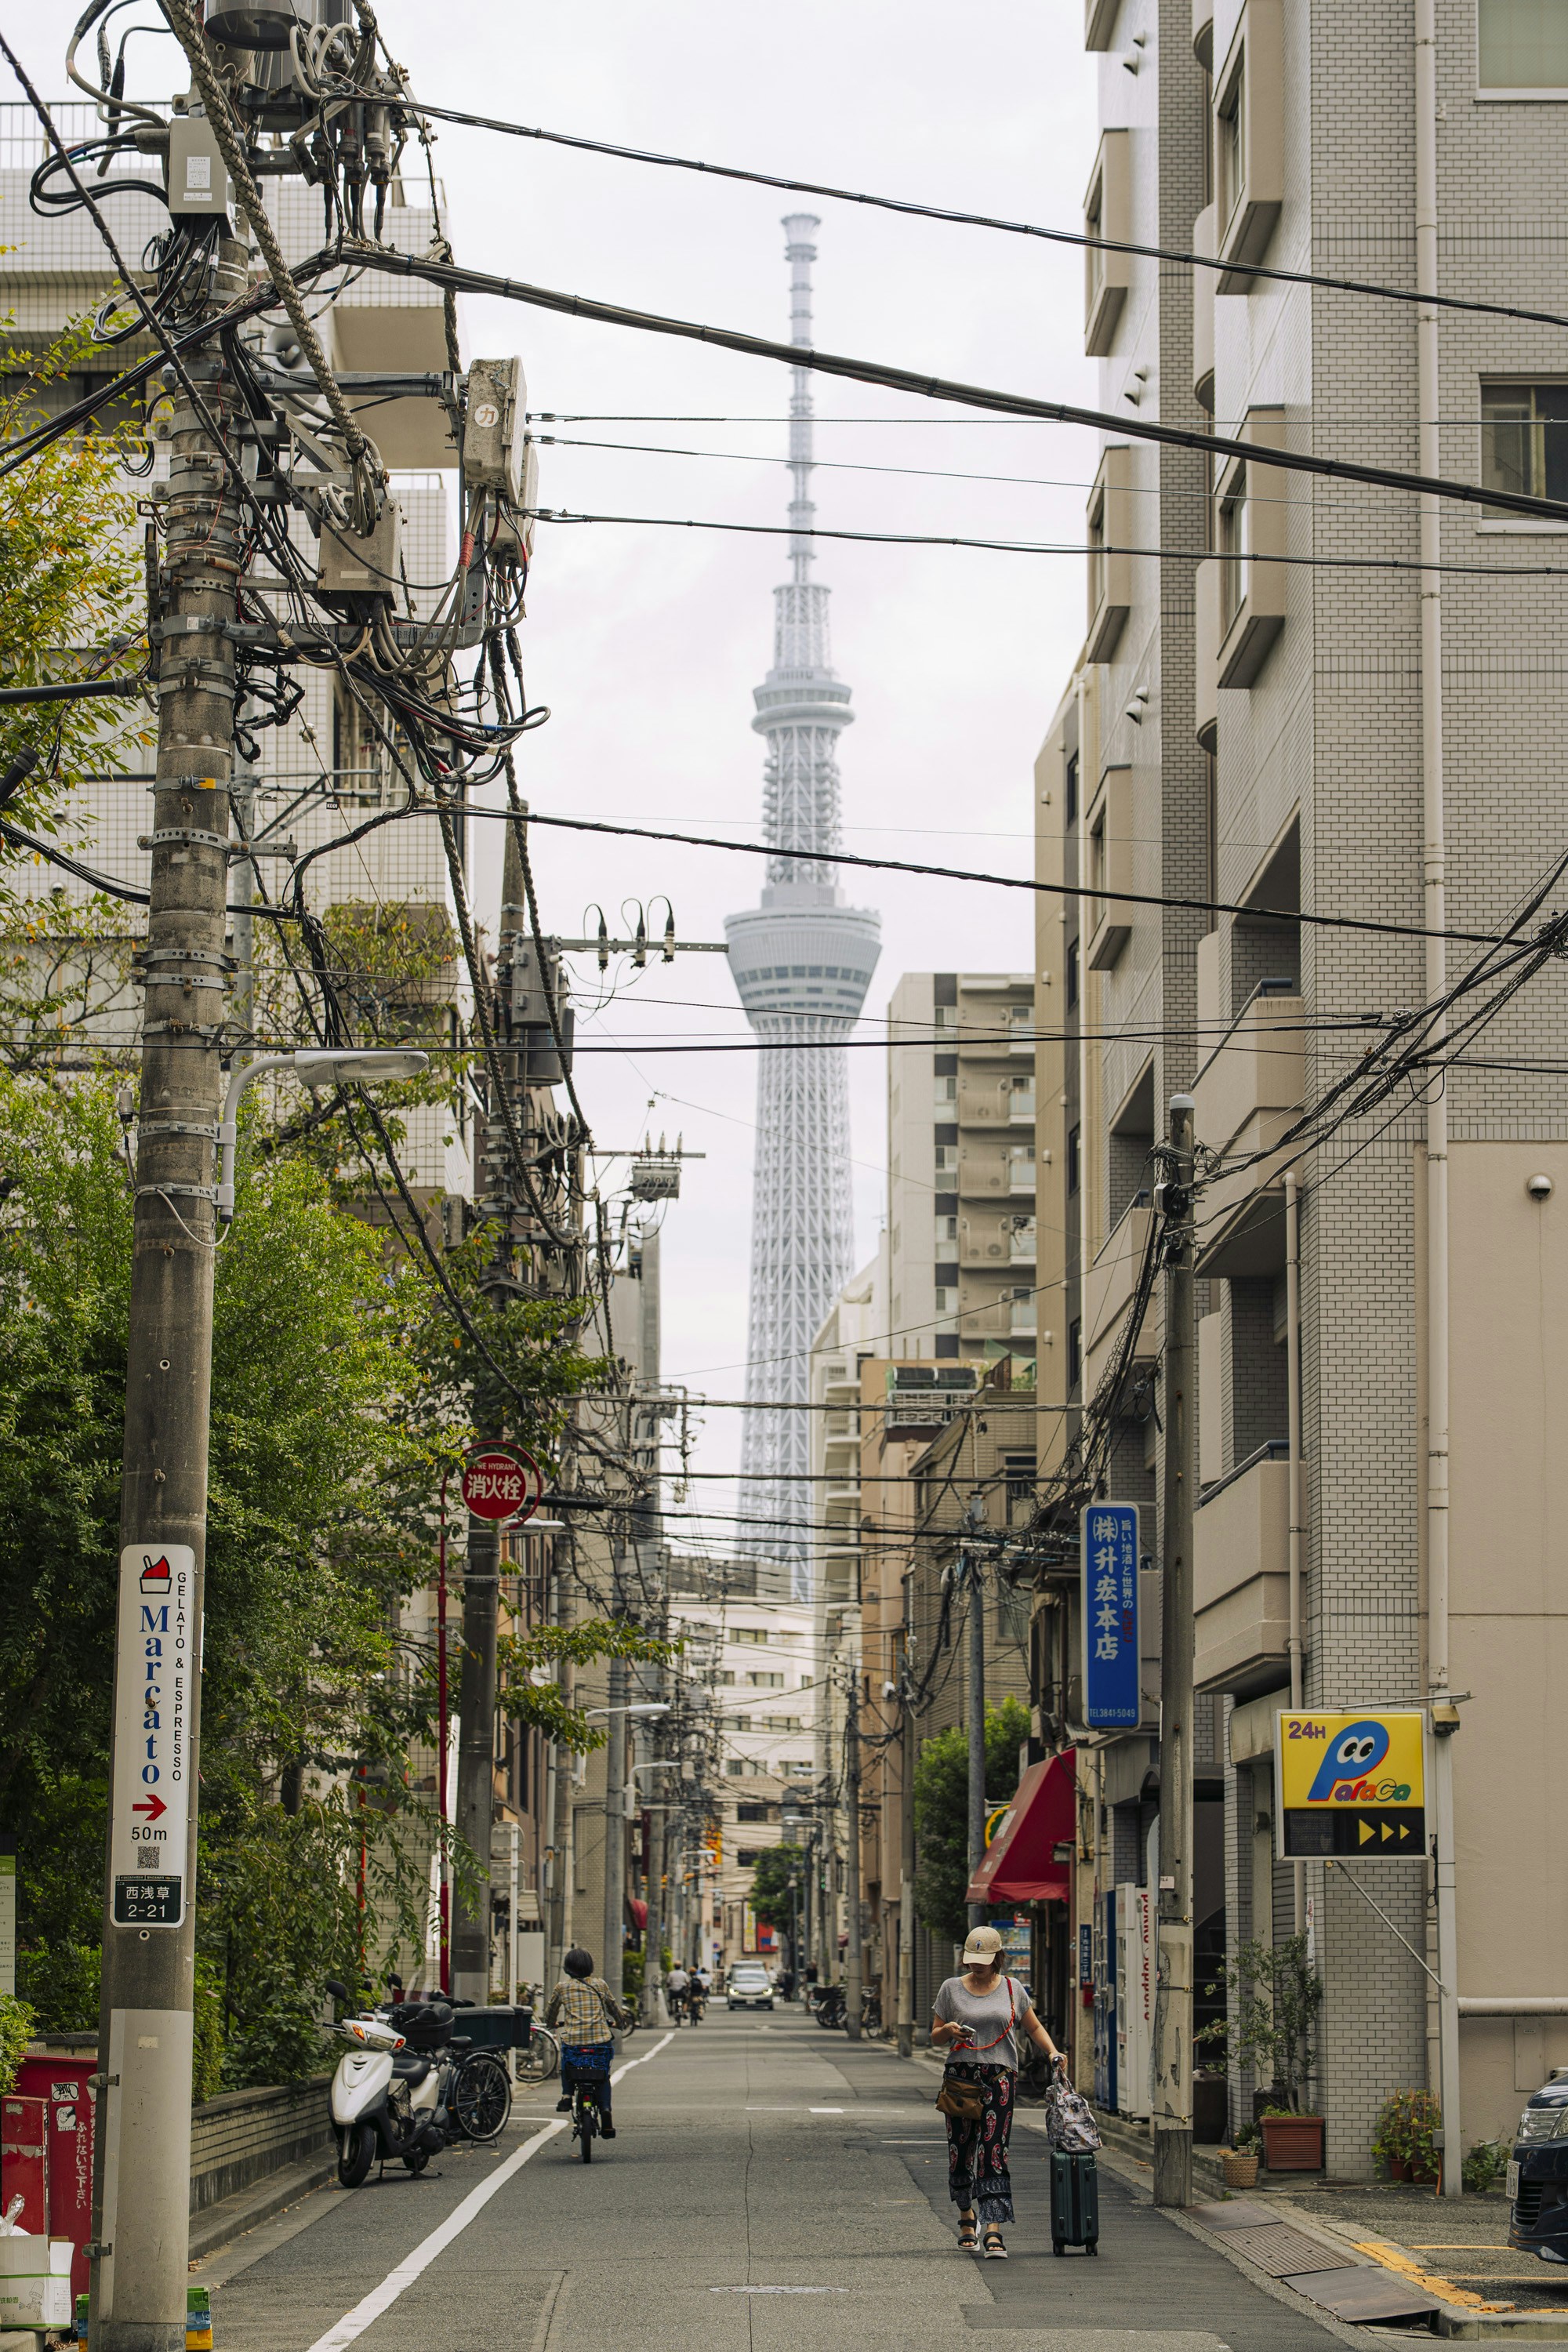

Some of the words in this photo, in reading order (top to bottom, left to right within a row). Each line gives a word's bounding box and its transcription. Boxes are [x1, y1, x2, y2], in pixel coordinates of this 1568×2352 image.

[479, 407, 495, 424] 力
[488, 1462, 517, 1471] HYDRANT
[466, 1474, 522, 1501] 消火栓
[175, 1572, 187, 1649] GELATO
[175, 1657, 184, 1669] &
[139, 1605, 171, 1784] Marcato
[172, 1677, 183, 1781] ESPRESSO
[1288, 1721, 1327, 1739] 24H
[131, 1827, 167, 1841] 50m
[125, 1886, 170, 1900] 西浅草
[128, 1904, 166, 1918] 2-21
[76, 2121, 88, 2209] ふれないで下さい
